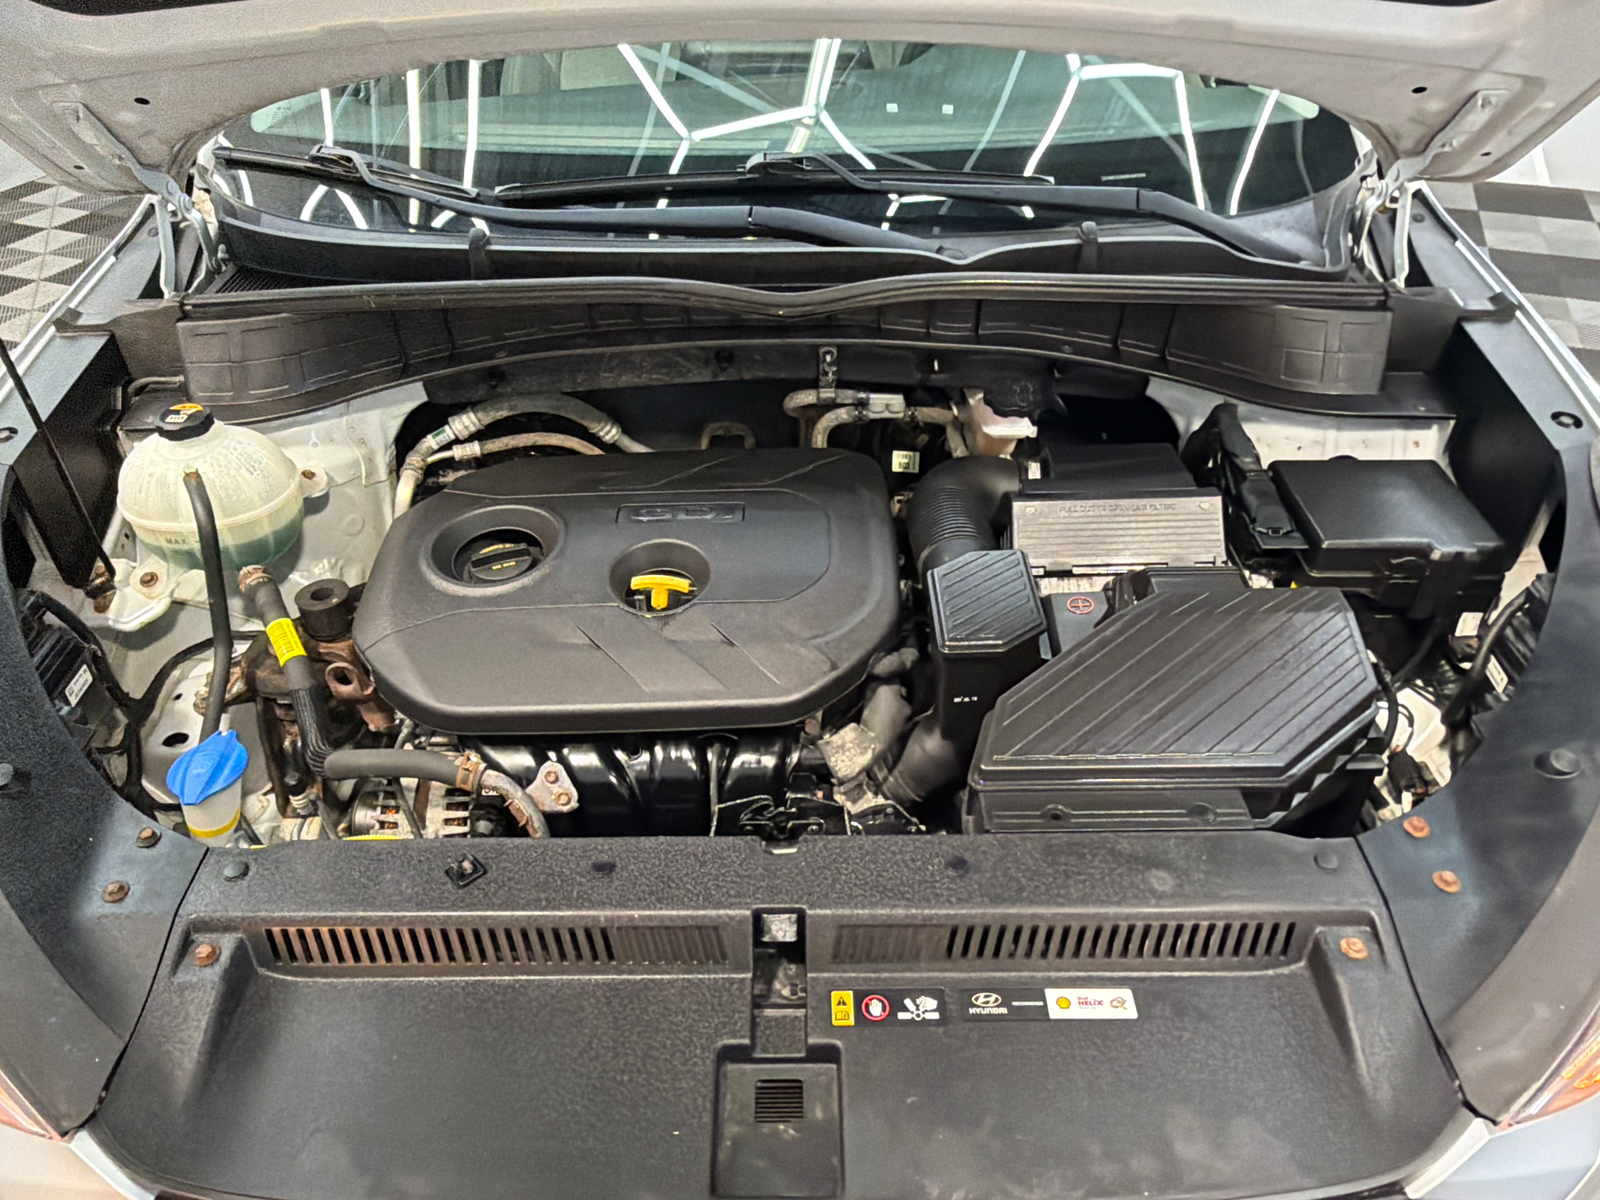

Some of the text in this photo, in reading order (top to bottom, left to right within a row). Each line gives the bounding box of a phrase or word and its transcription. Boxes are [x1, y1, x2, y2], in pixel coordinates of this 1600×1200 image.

[1059, 504, 1079, 513] PULL
[1080, 503, 1096, 513] OUT
[165, 537, 188, 546] MAX
